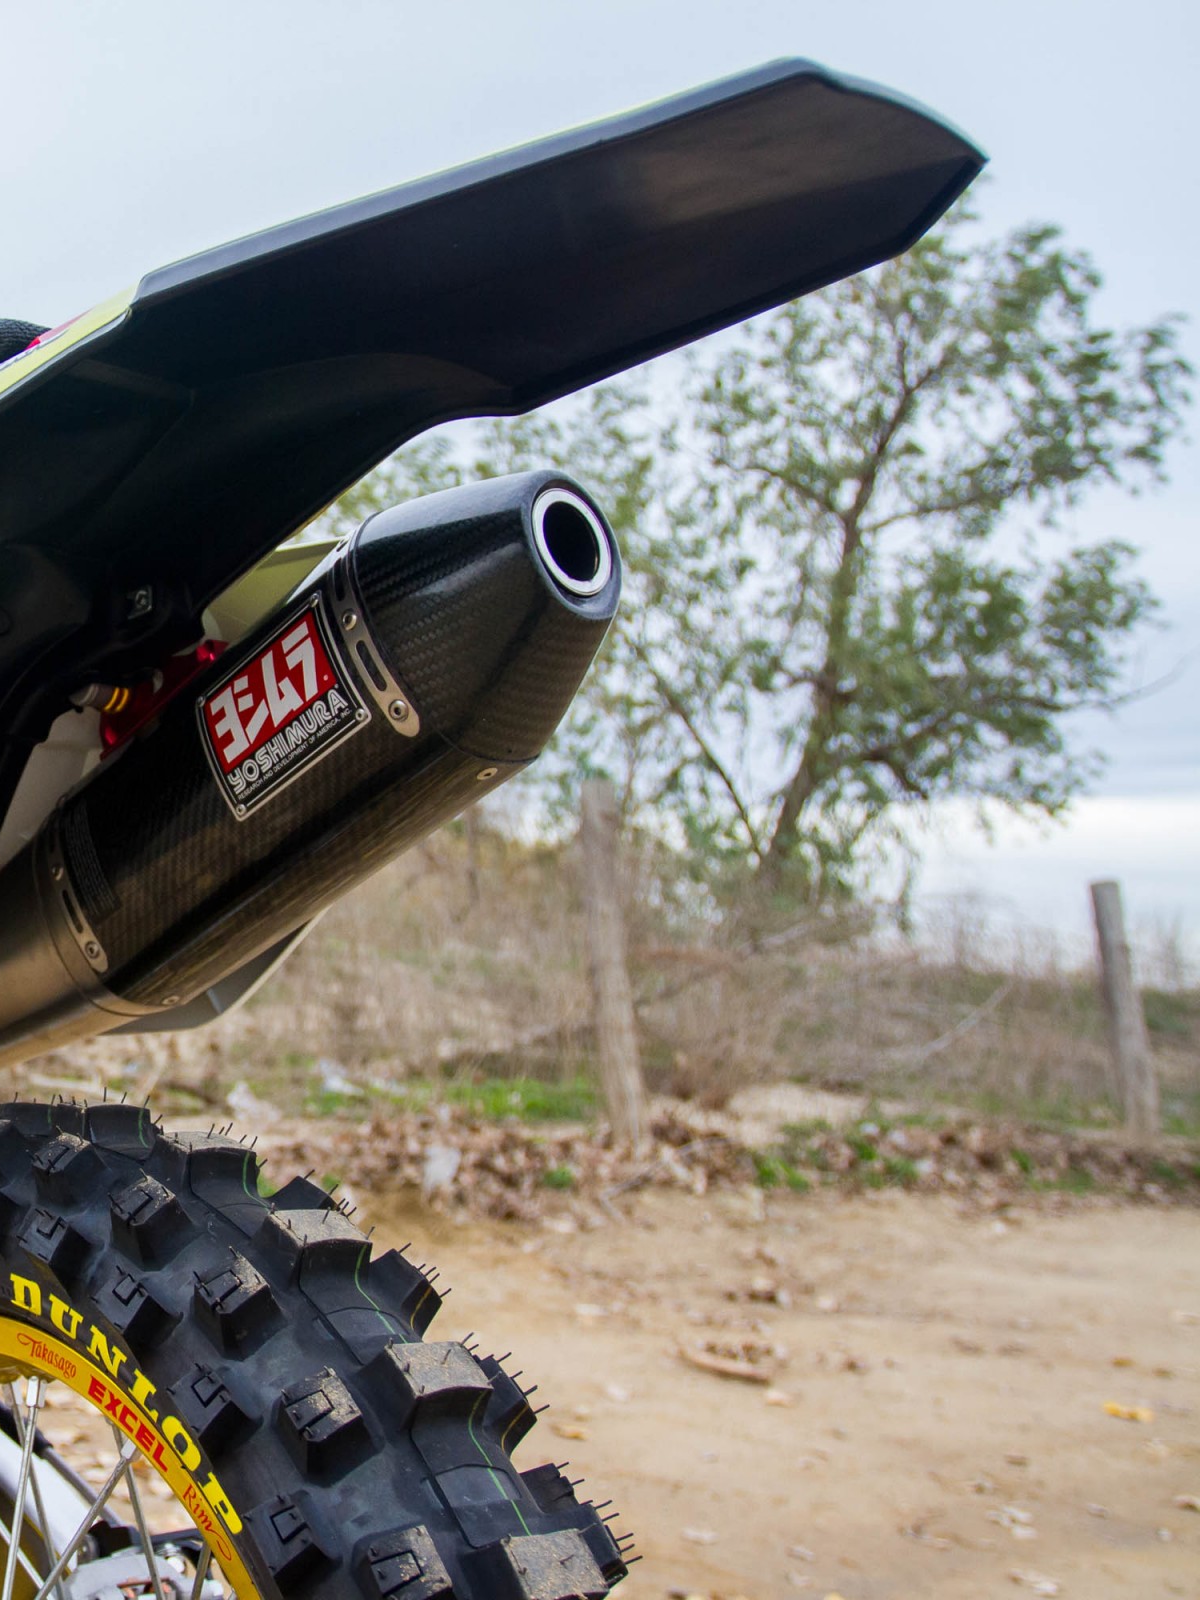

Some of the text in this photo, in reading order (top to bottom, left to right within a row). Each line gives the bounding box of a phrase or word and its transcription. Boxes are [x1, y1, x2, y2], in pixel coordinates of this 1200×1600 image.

[227, 688, 349, 796] YOSHIMURA
[238, 777, 264, 800] RESEARCH
[273, 742, 310, 773] DEVELOPMENT
[9, 1273, 243, 1534] DUNLOP
[17, 1332, 232, 1562] Takasago EXCEL Rim
